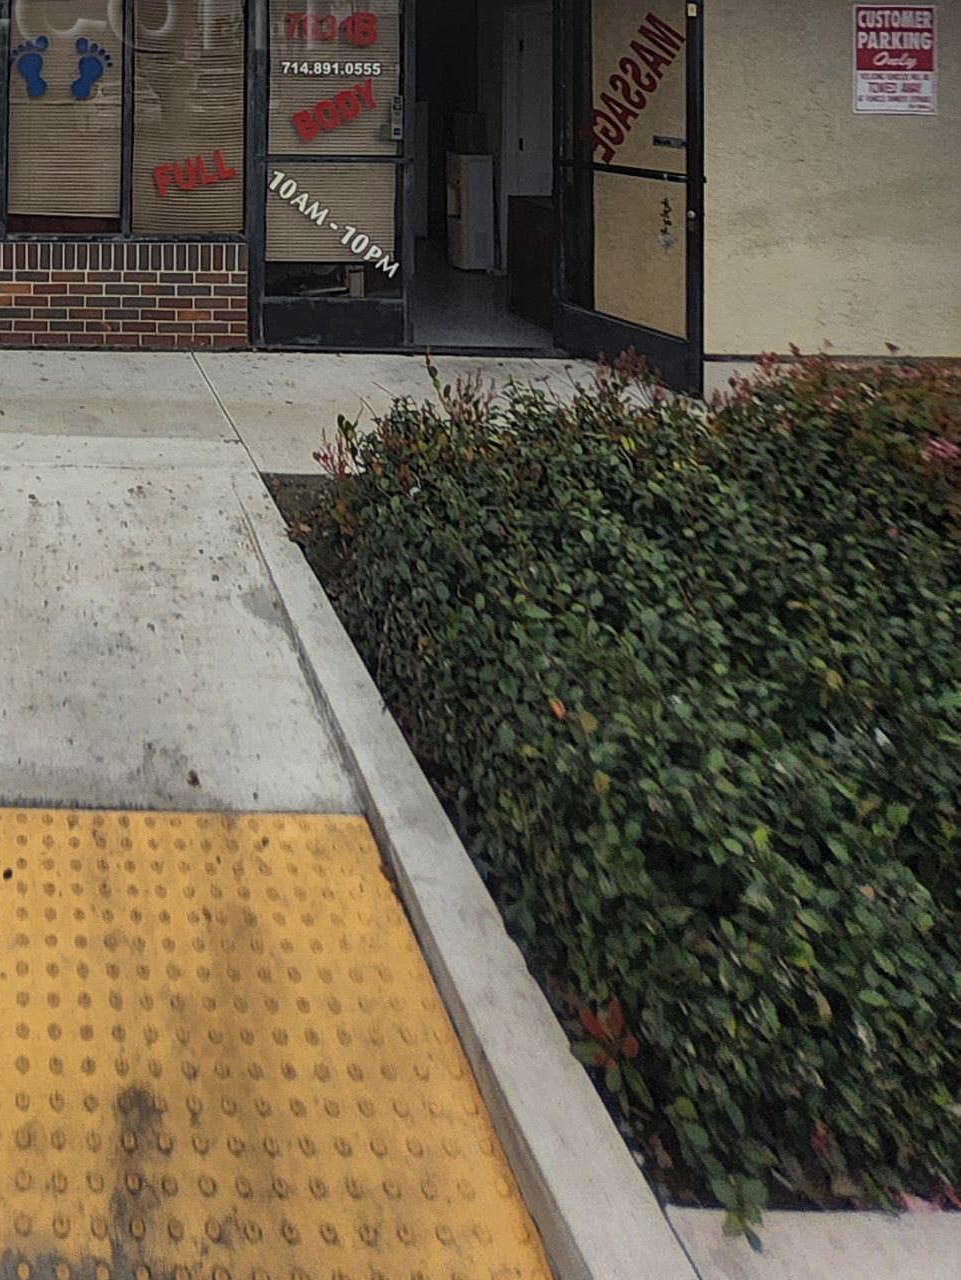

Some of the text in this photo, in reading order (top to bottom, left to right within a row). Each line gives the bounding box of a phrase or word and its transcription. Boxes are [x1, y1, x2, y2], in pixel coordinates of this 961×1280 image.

[858, 10, 932, 28] CUSTOMER
[858, 31, 933, 50] PARKING
[281, 61, 382, 76] 714.891.0555
[291, 77, 377, 144] BODY
[151, 148, 236, 199] FULL
[269, 170, 329, 226] 10AM
[341, 225, 400, 278] 10PM
